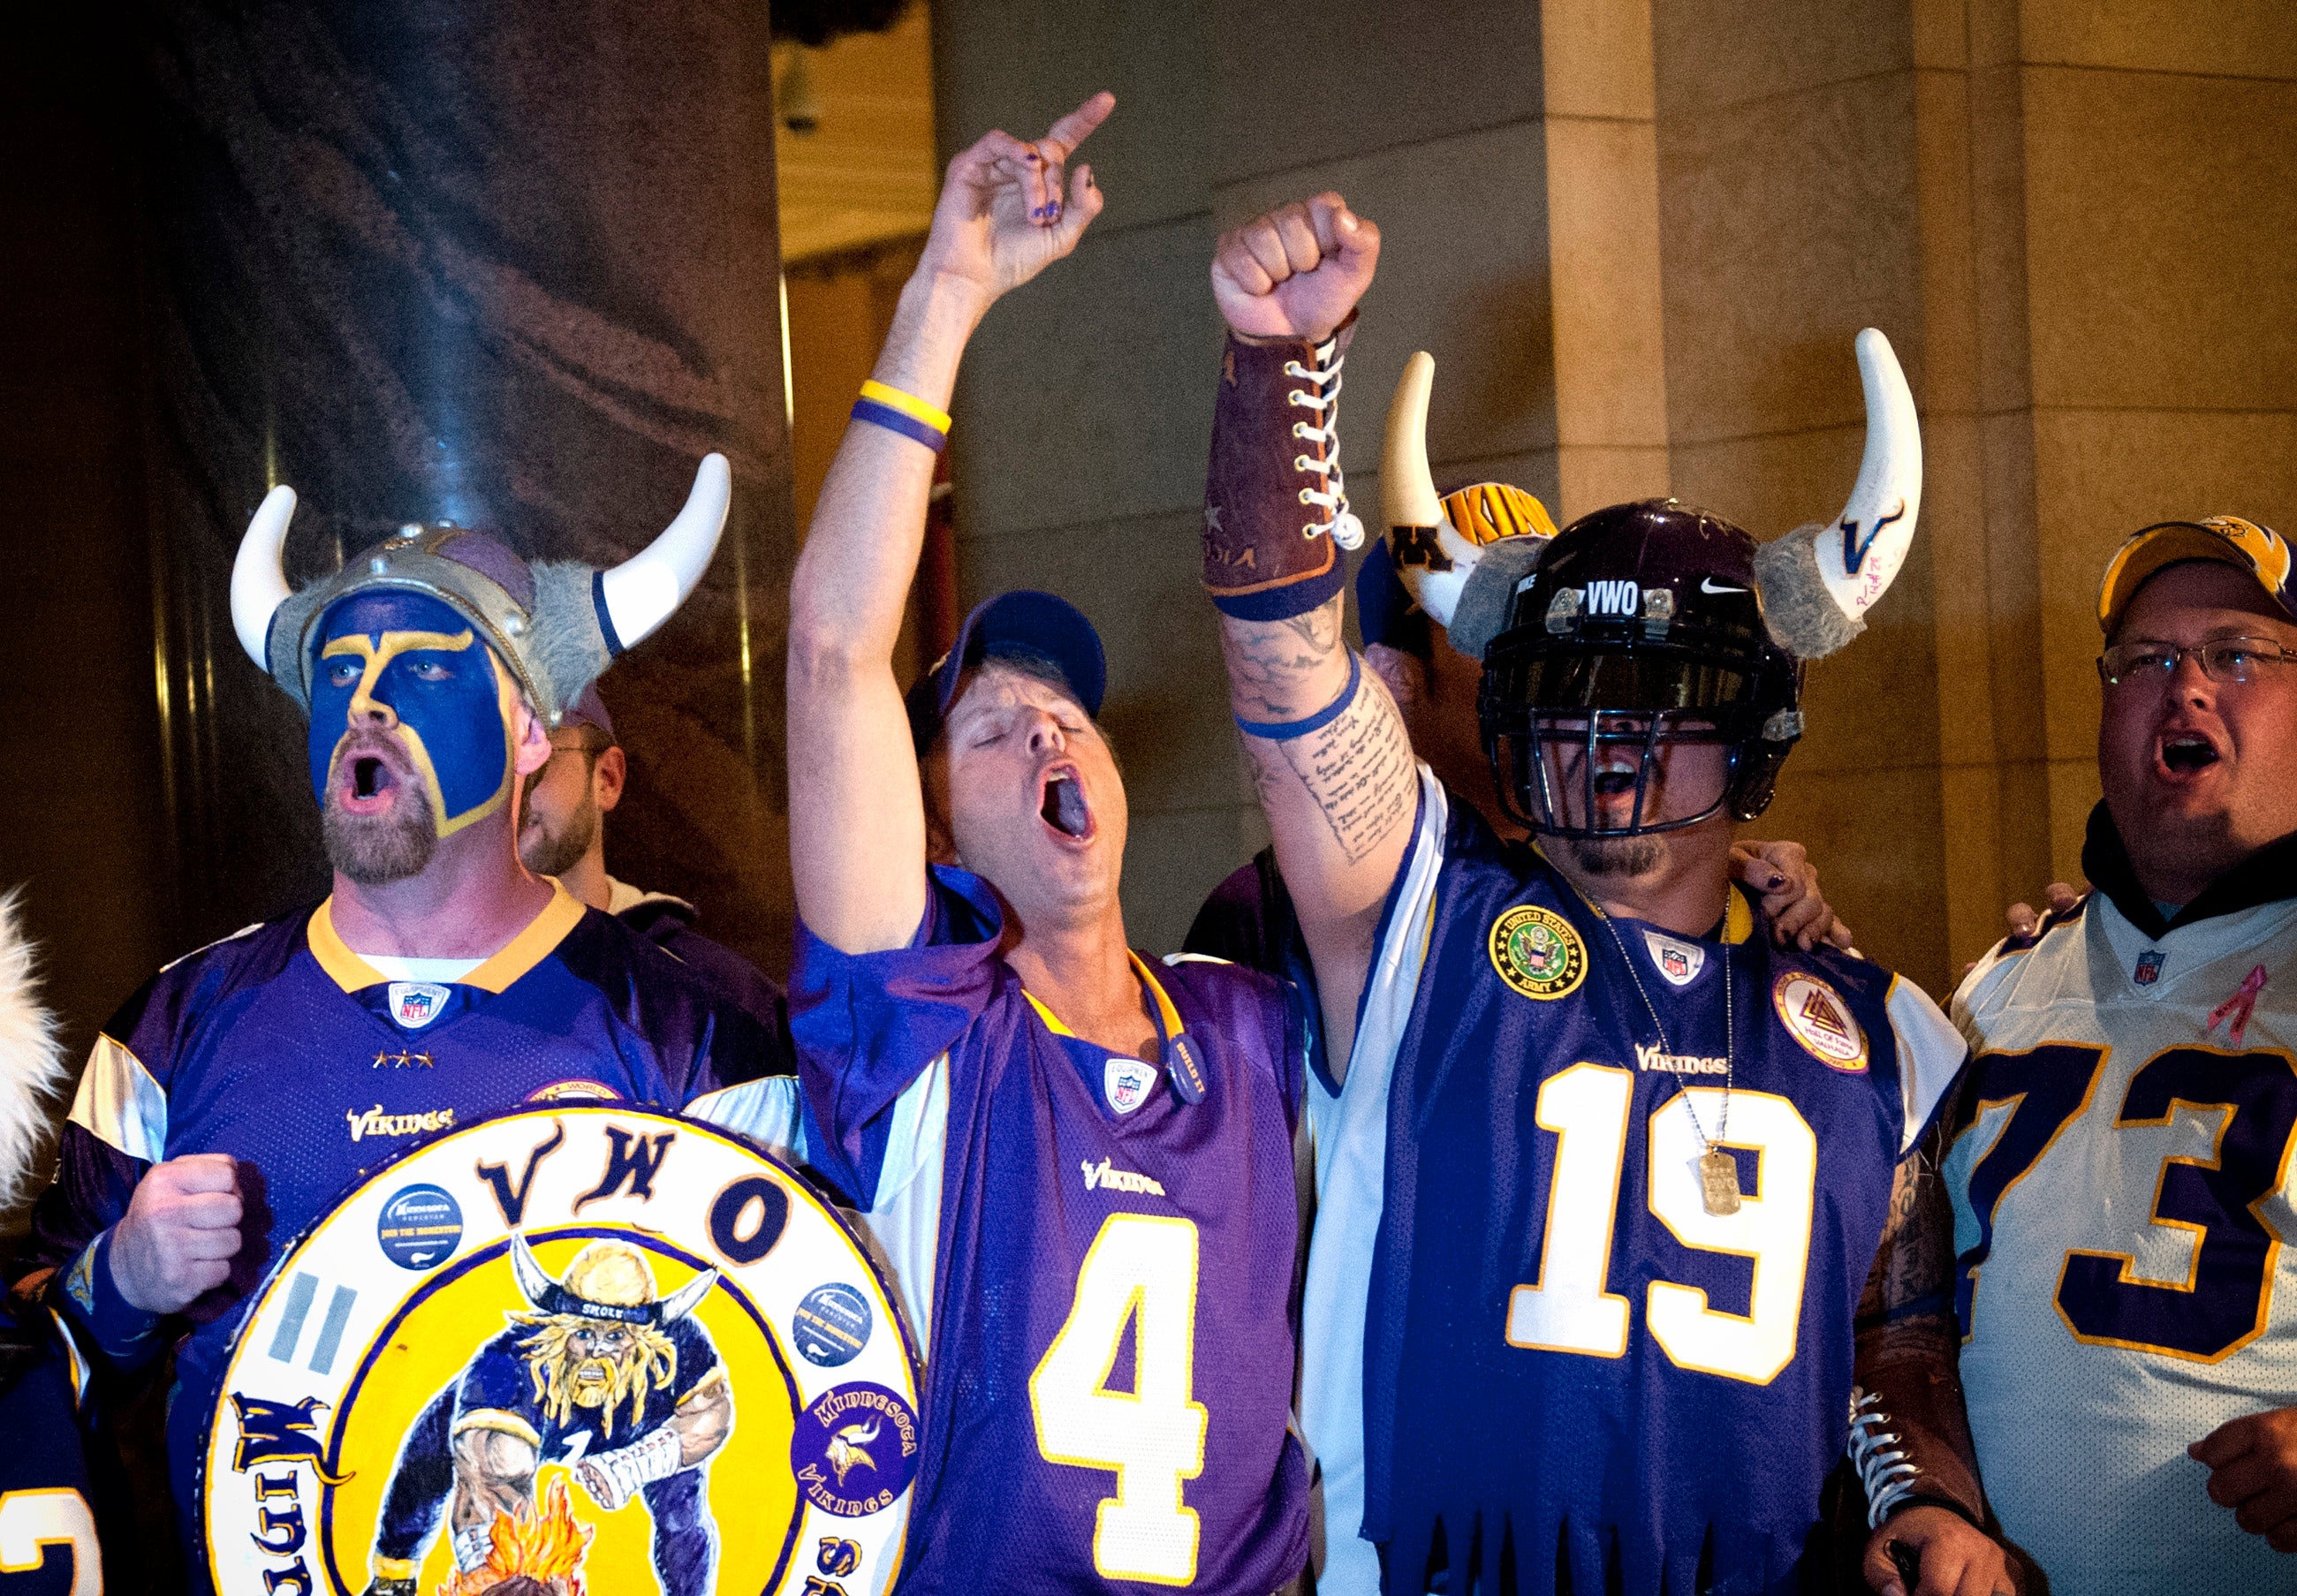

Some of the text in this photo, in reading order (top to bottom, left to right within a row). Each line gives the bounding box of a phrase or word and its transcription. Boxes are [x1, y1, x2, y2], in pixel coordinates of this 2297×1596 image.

[1440, 483, 1558, 548] KIN
[1588, 580, 1638, 616] VWO
[1505, 911, 1575, 945] UNITED STATES
[1519, 979, 1551, 992] ARMY
[403, 1003, 427, 1019] NFL
[1176, 1041, 1199, 1079] BUILD
[1194, 1078, 1205, 1093] IT
[567, 1083, 608, 1097] WORLD
[1116, 1087, 1136, 1103] NFL
[1506, 1062, 1817, 1386] 19
[1953, 1040, 2297, 1365] 73
[399, 1228, 415, 1237] THE
[1028, 1212, 1209, 1587] 4
[814, 1389, 918, 1457] MINNESOTA
[798, 1463, 893, 1517] VIKINGS
